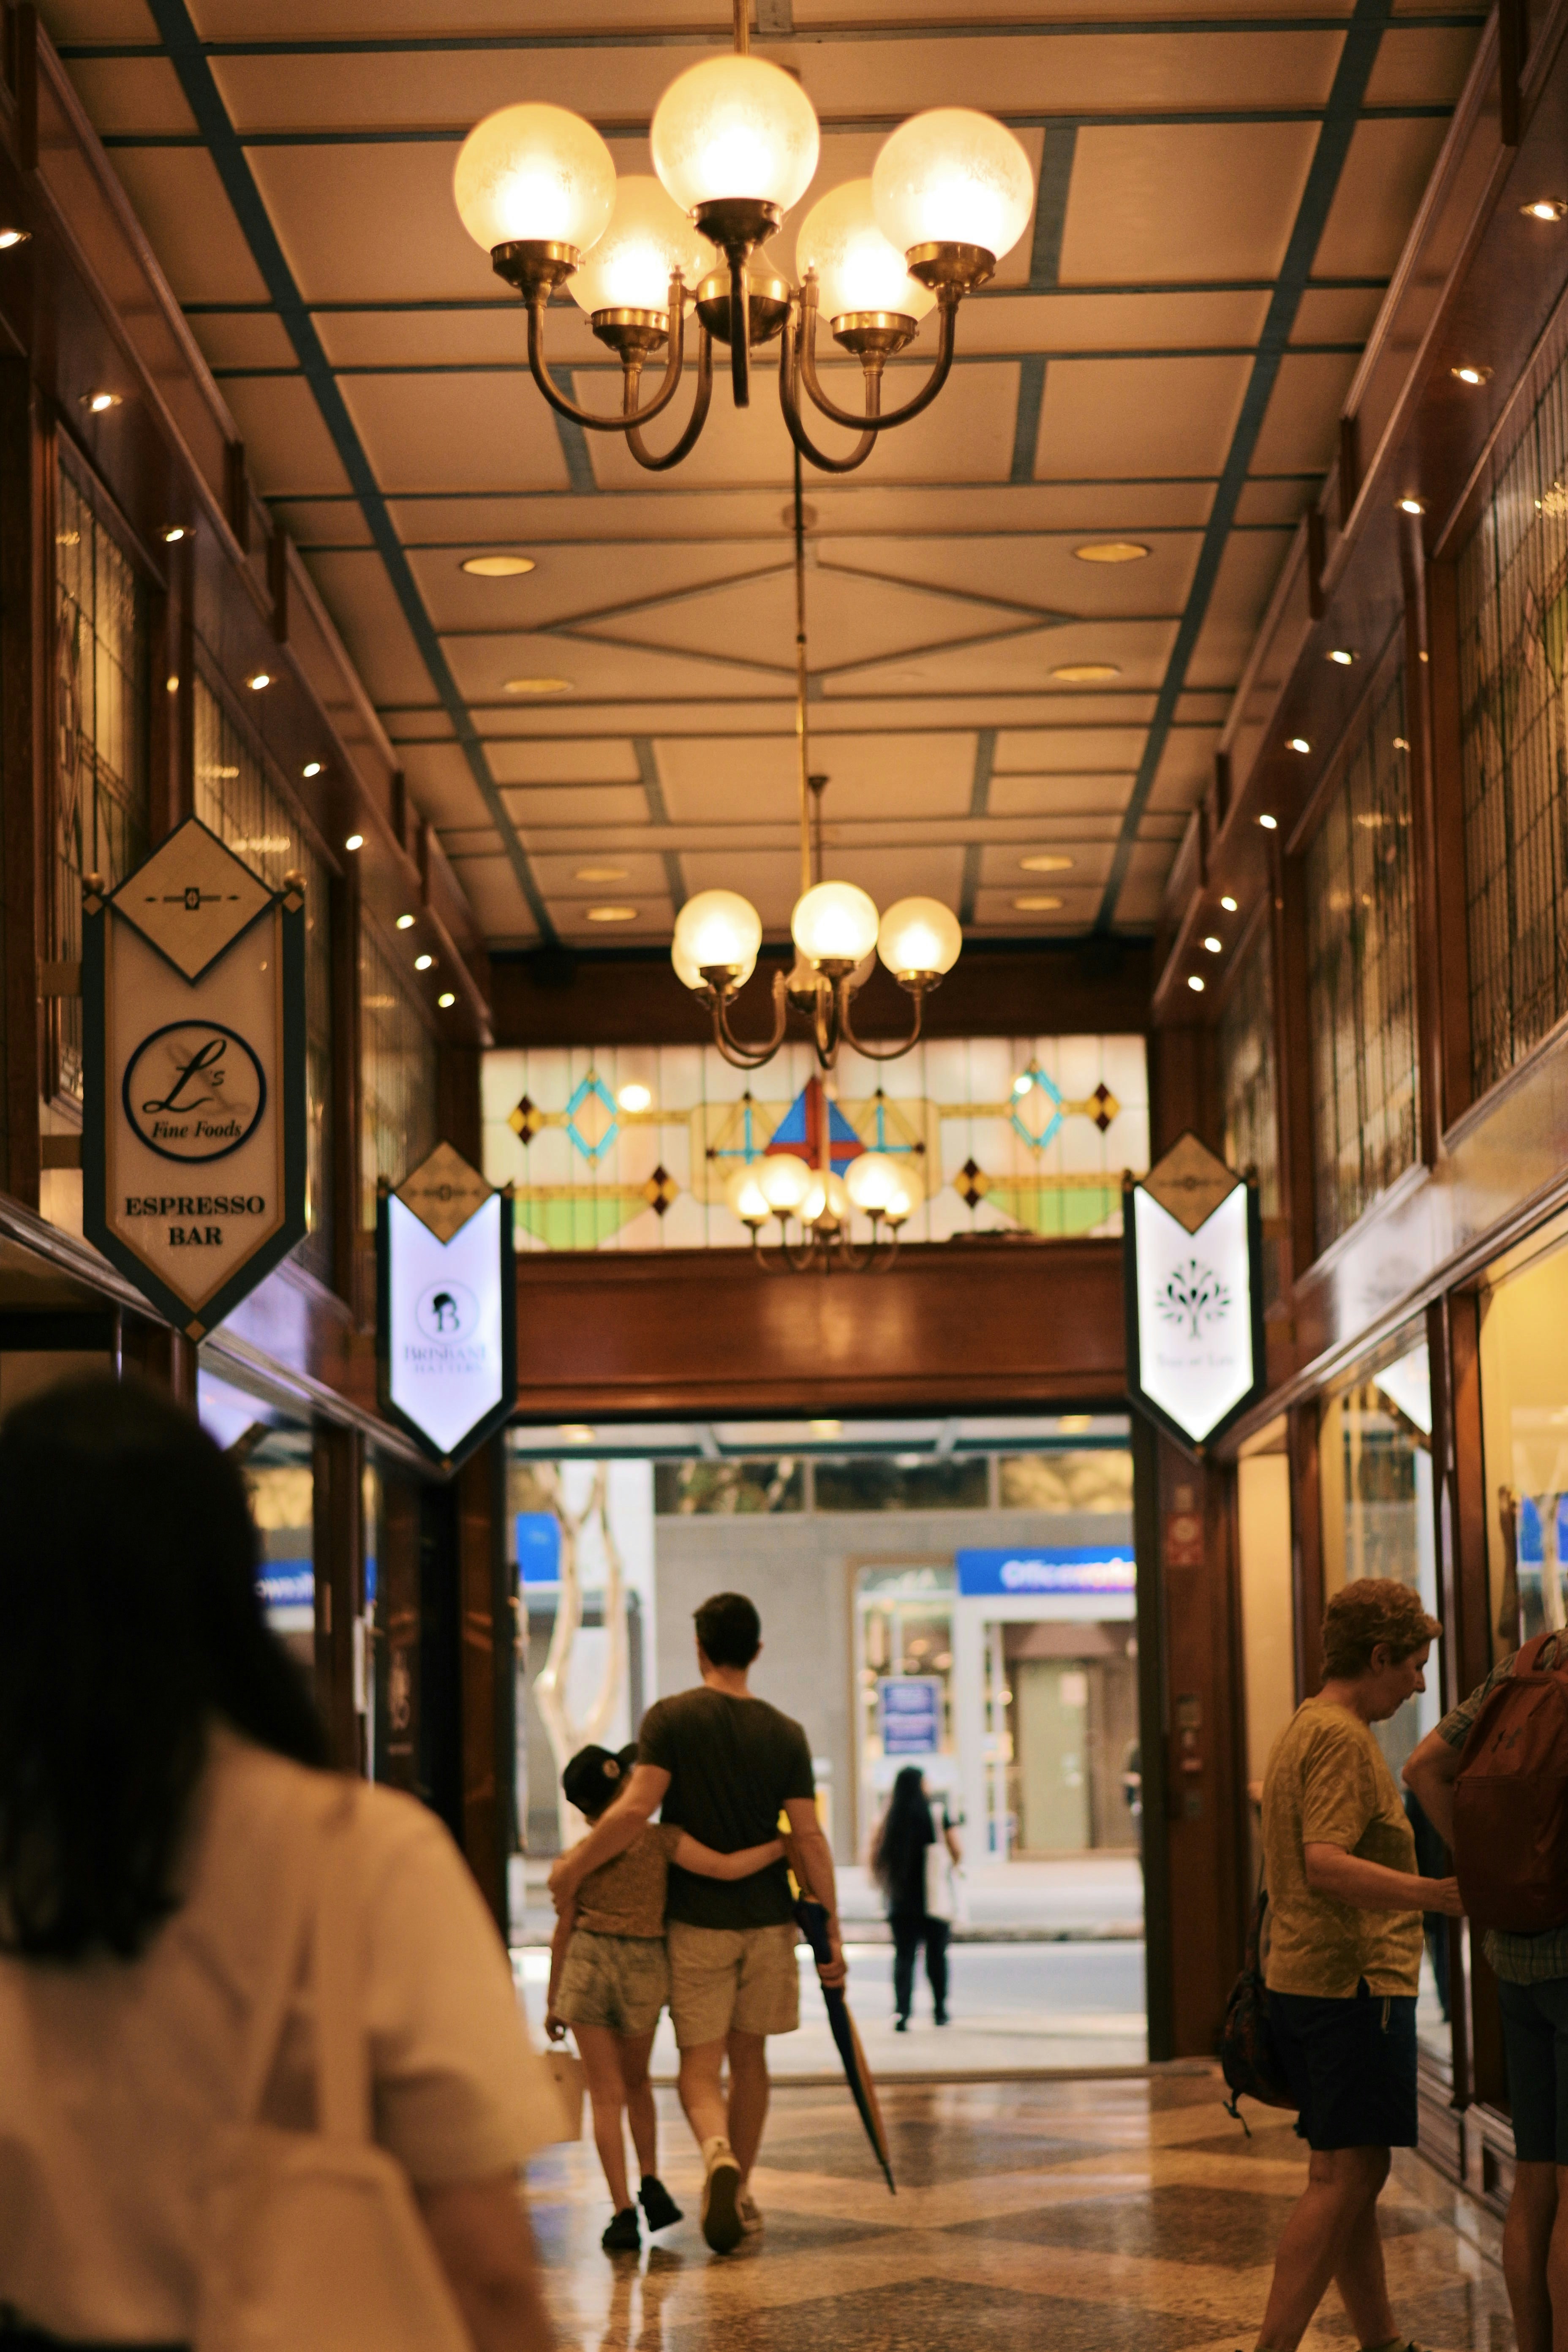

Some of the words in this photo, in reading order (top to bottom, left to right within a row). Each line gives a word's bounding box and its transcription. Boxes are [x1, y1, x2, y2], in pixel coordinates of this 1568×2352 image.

[142, 1039, 227, 1113] L's
[152, 1121, 188, 1138] Fine
[194, 1119, 242, 1138] Foods
[125, 1196, 266, 1216] ESPRESSO
[169, 1226, 223, 1246] BAR
